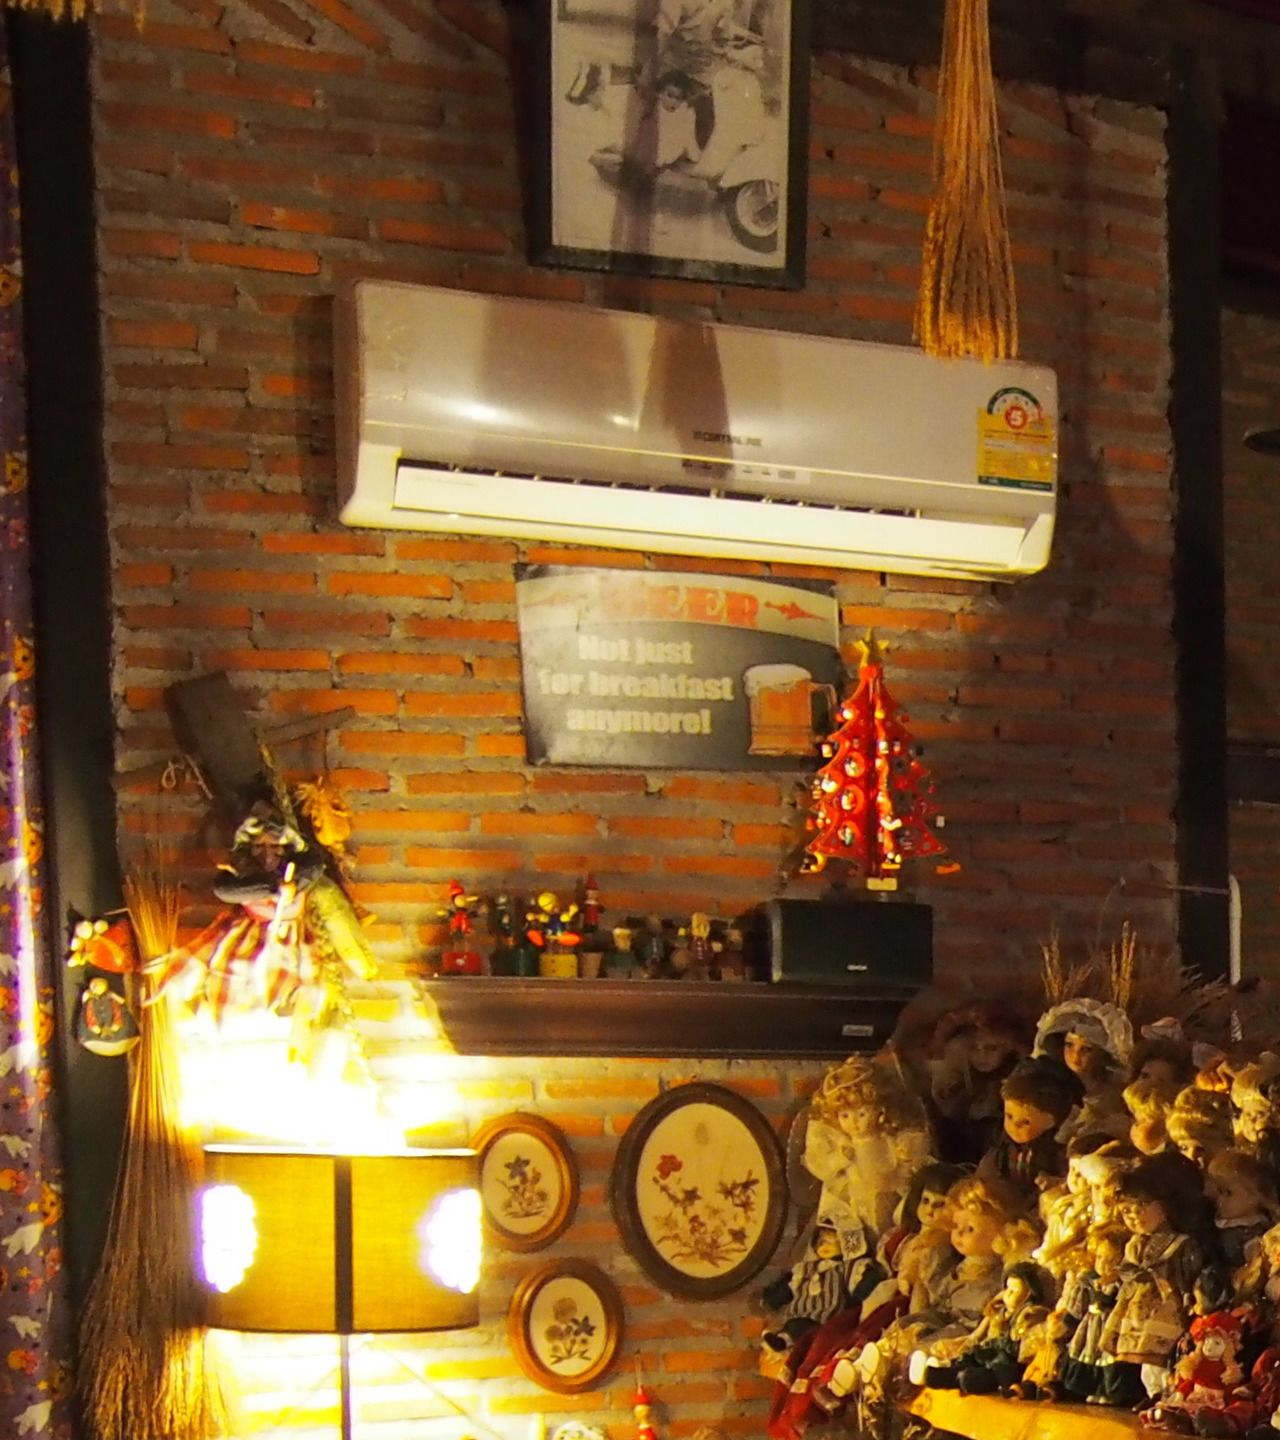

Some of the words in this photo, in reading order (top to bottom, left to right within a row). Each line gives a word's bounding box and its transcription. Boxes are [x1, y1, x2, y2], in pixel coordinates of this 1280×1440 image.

[578, 634, 631, 663] Not
[634, 639, 694, 666] just
[539, 668, 585, 696] for
[587, 670, 735, 702] breakfast
[565, 707, 712, 736] anymore!
